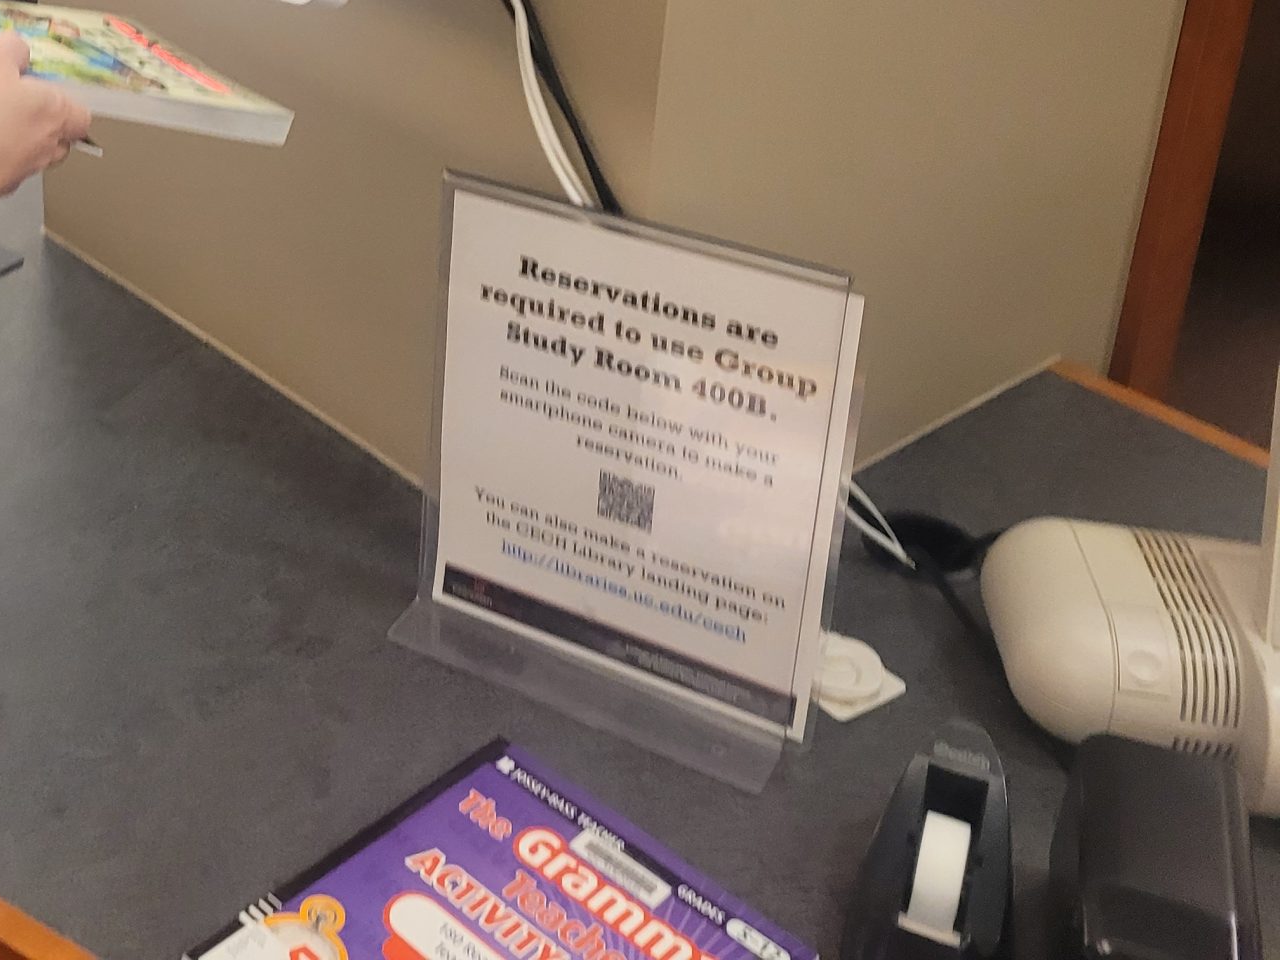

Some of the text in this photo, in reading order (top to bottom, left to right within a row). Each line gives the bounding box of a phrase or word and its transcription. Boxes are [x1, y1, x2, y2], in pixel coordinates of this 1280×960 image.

[480, 284, 818, 402] required to use Group
[519, 254, 779, 349] Reservations are
[500, 364, 778, 467] Scan the code below with your
[506, 320, 778, 422] Study Room 400B.
[500, 389, 774, 488] smartphone camera to make a
[576, 434, 684, 483] reservation.
[474, 485, 786, 610] You can also make a reservation on
[486, 511, 511, 531] the
[573, 540, 636, 578] Library
[642, 567, 710, 607] landing
[459, 788, 513, 841] The
[514, 827, 725, 960] Gramm
[677, 883, 726, 926] GRADES
